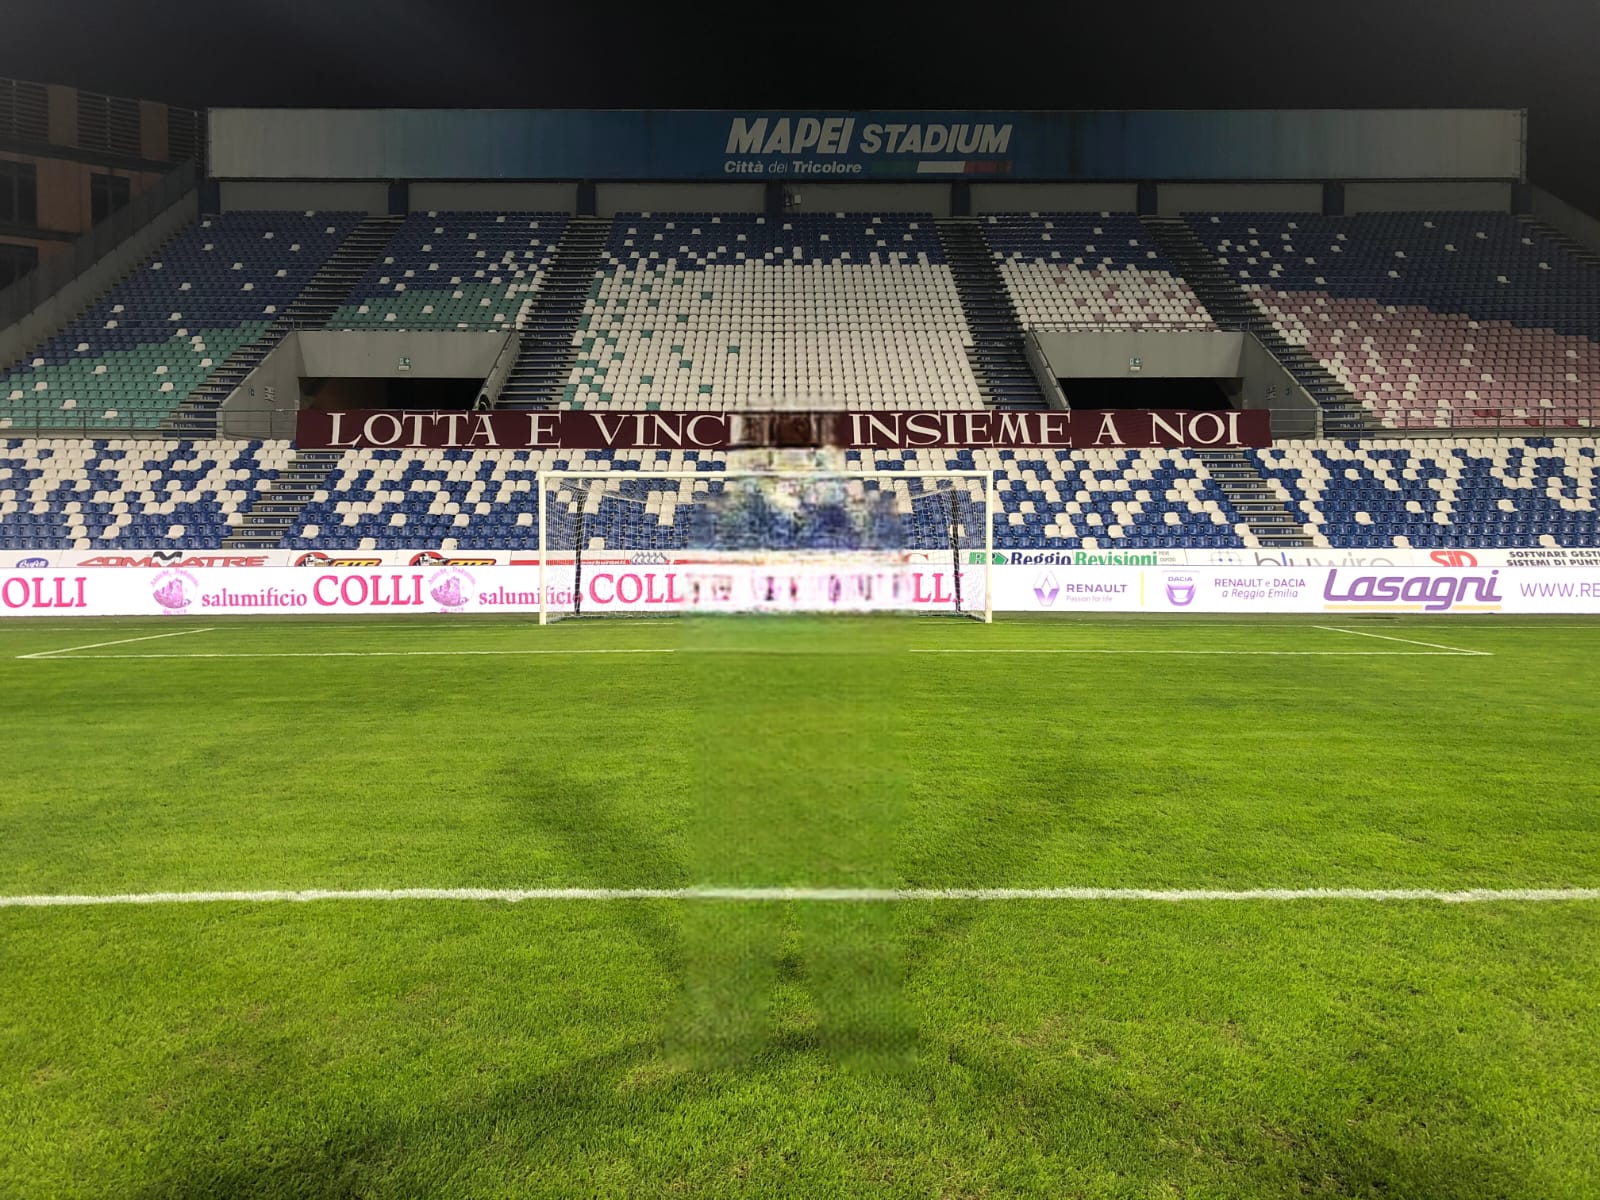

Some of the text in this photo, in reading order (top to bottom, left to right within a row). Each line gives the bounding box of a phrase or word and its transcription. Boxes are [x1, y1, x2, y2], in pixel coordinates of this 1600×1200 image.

[724, 117, 1012, 153] MAPEI STADIUM
[724, 160, 763, 173] Città
[792, 160, 862, 173] Tricolore
[327, 411, 500, 448] LOTTA
[525, 411, 562, 447] E
[849, 410, 1073, 447] INSIEME
[1092, 412, 1127, 446] A
[1147, 411, 1243, 445] NOI
[1011, 552, 1072, 565] Reggio
[1075, 551, 1158, 565] Revisioni
[1508, 550, 1568, 558] SOFTWARE
[1066, 583, 1128, 593] RENAULT
[1214, 578, 1306, 588] RENAULT e DACIA
[1323, 568, 1503, 611] Lasagni
[202, 588, 307, 607] salumificio
[313, 575, 424, 607] COLLI
[1222, 588, 1299, 600] a Reggio Emilia
